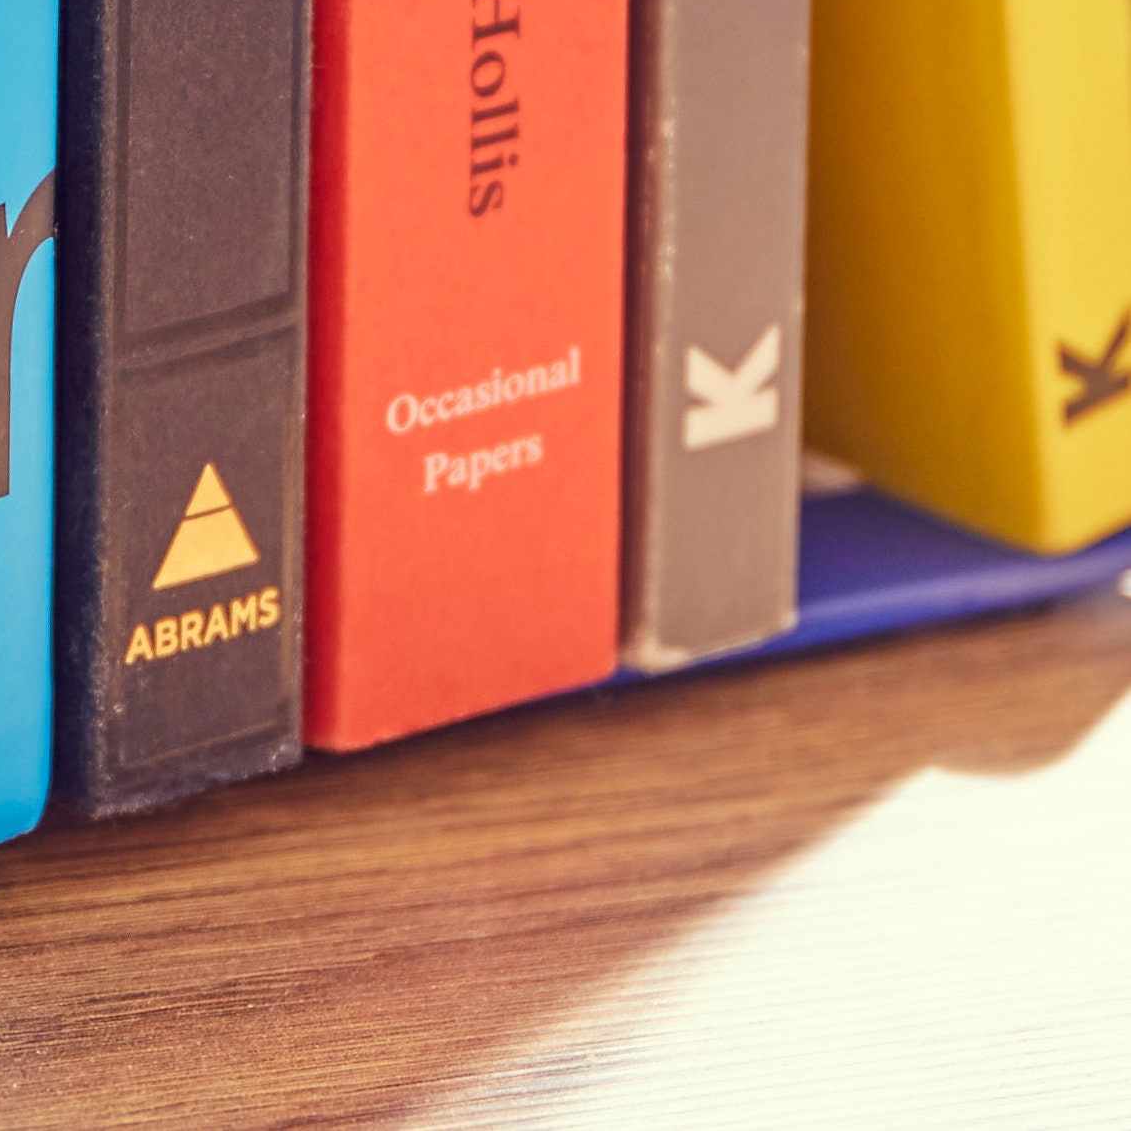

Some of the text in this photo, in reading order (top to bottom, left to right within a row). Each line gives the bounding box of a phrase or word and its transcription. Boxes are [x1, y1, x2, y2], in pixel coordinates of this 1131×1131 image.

[385, 345, 581, 436] Occasional
[423, 433, 544, 494] Papers
[124, 584, 282, 666] ABRAMS
